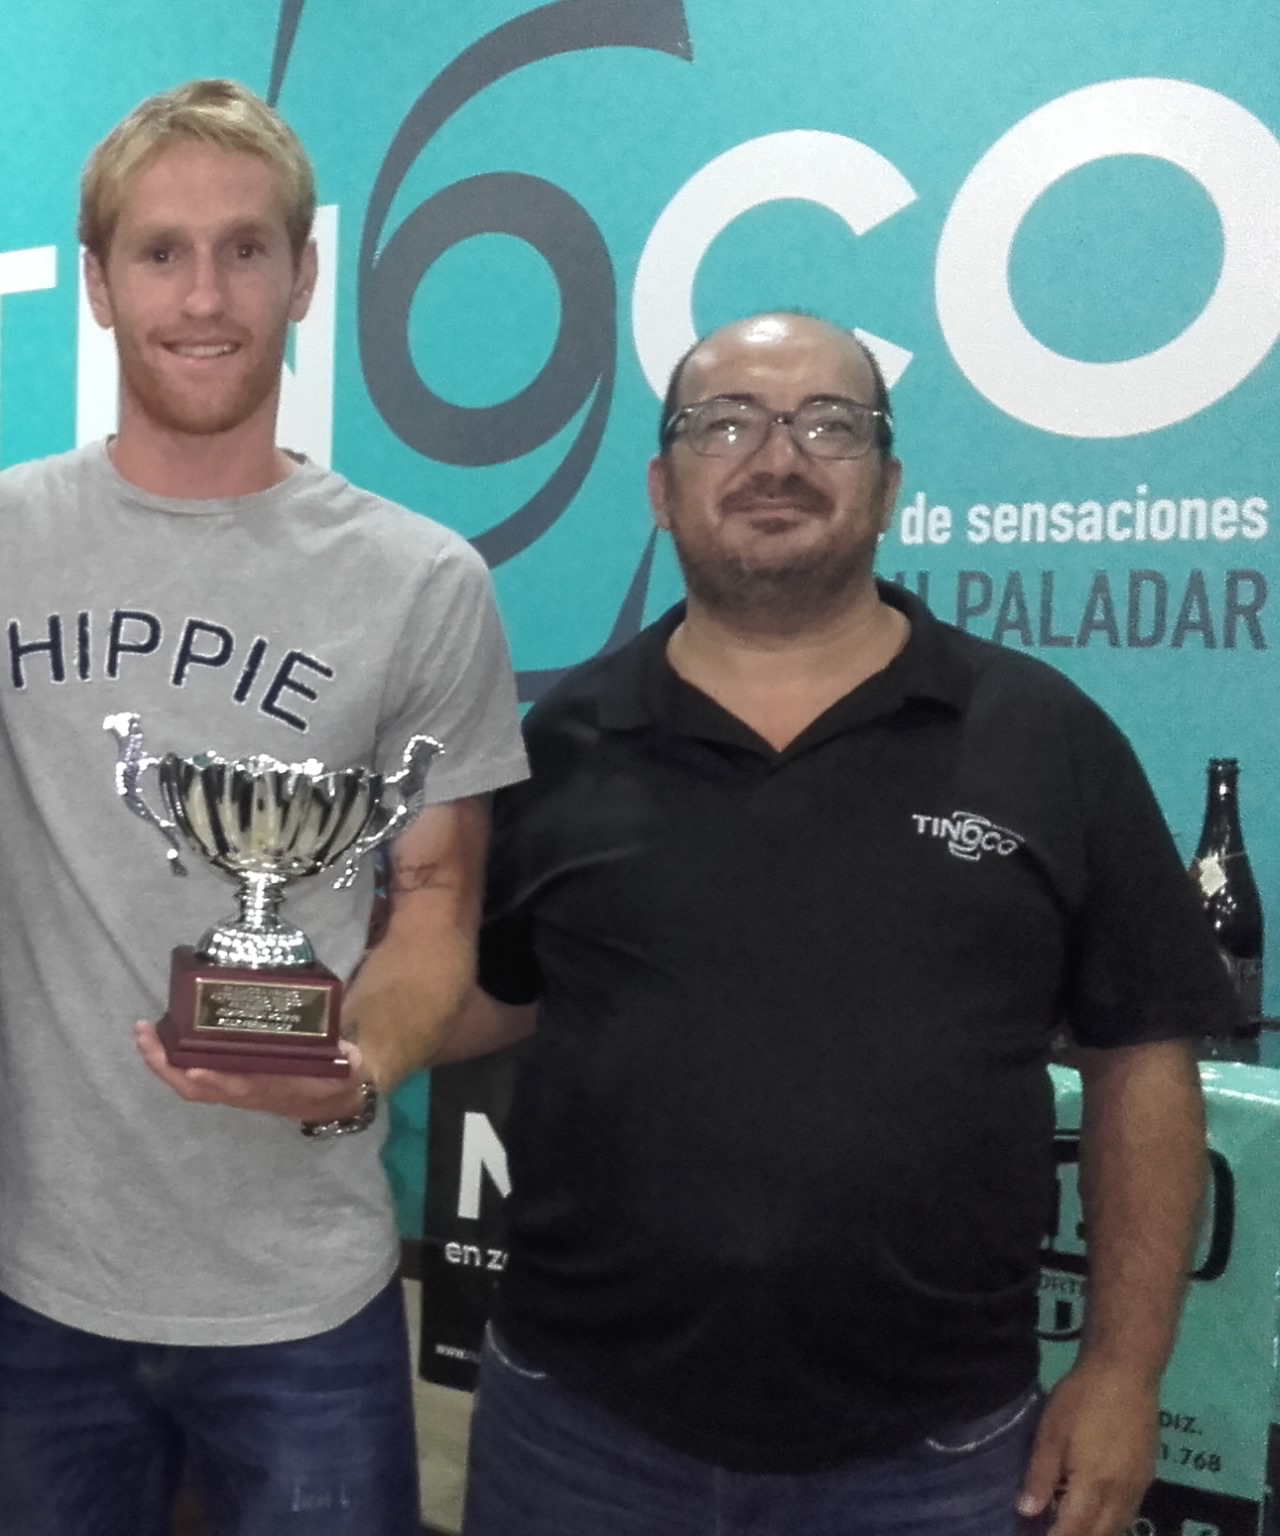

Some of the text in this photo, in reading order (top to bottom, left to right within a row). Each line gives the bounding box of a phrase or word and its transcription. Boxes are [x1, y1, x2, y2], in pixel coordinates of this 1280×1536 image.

[900, 483, 1269, 544] de sensaciones
[956, 567, 1270, 650] PALADAR
[7, 608, 336, 732] HIPPIE
[445, 1241, 481, 1267] en
